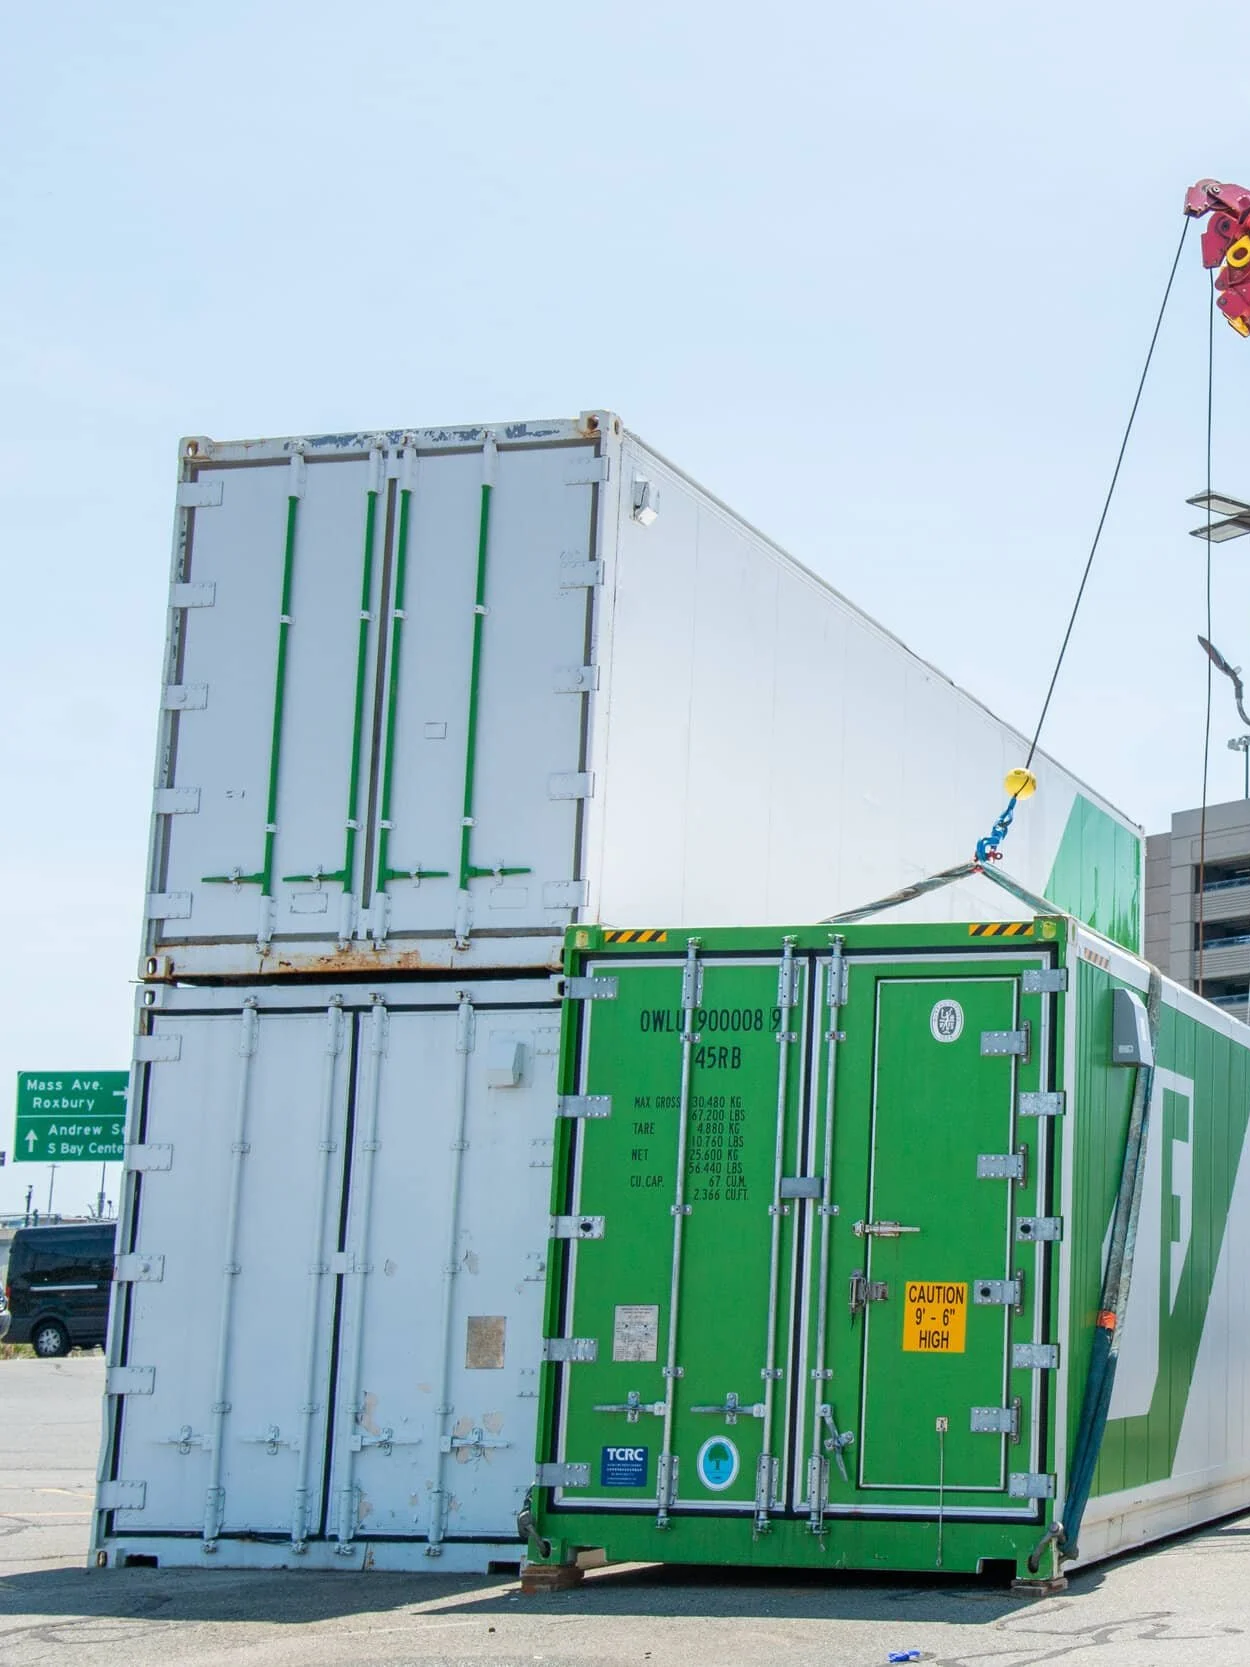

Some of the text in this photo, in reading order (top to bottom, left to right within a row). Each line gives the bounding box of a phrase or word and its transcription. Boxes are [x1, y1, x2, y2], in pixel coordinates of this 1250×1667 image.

[641, 1009, 782, 1032] OWLU 900008 9
[695, 1046, 741, 1069] 45RB
[26, 1079, 103, 1091] Mass Ave.
[33, 1096, 95, 1111] Roxbury
[634, 1096, 650, 1109] MAX
[655, 1096, 681, 1109] GROSS
[730, 1096, 742, 1108] KG
[729, 1109, 745, 1121] LBS
[48, 1124, 102, 1136] Andrew
[633, 1122, 655, 1134] TARE
[728, 1122, 740, 1134] KG
[728, 1135, 744, 1147] LBS
[48, 1143, 56, 1154] S
[60, 1143, 84, 1156] Bay
[631, 1149, 648, 1161] NET
[727, 1148, 738, 1160] KG
[726, 1162, 743, 1174] LBS
[709, 1175, 720, 1188] 67
[908, 1285, 964, 1304] CAUTION
[915, 1307, 926, 1325] 9'
[942, 1308, 955, 1326] 6"
[918, 1330, 950, 1349] HIGH
[606, 1447, 644, 1461] TCRC
